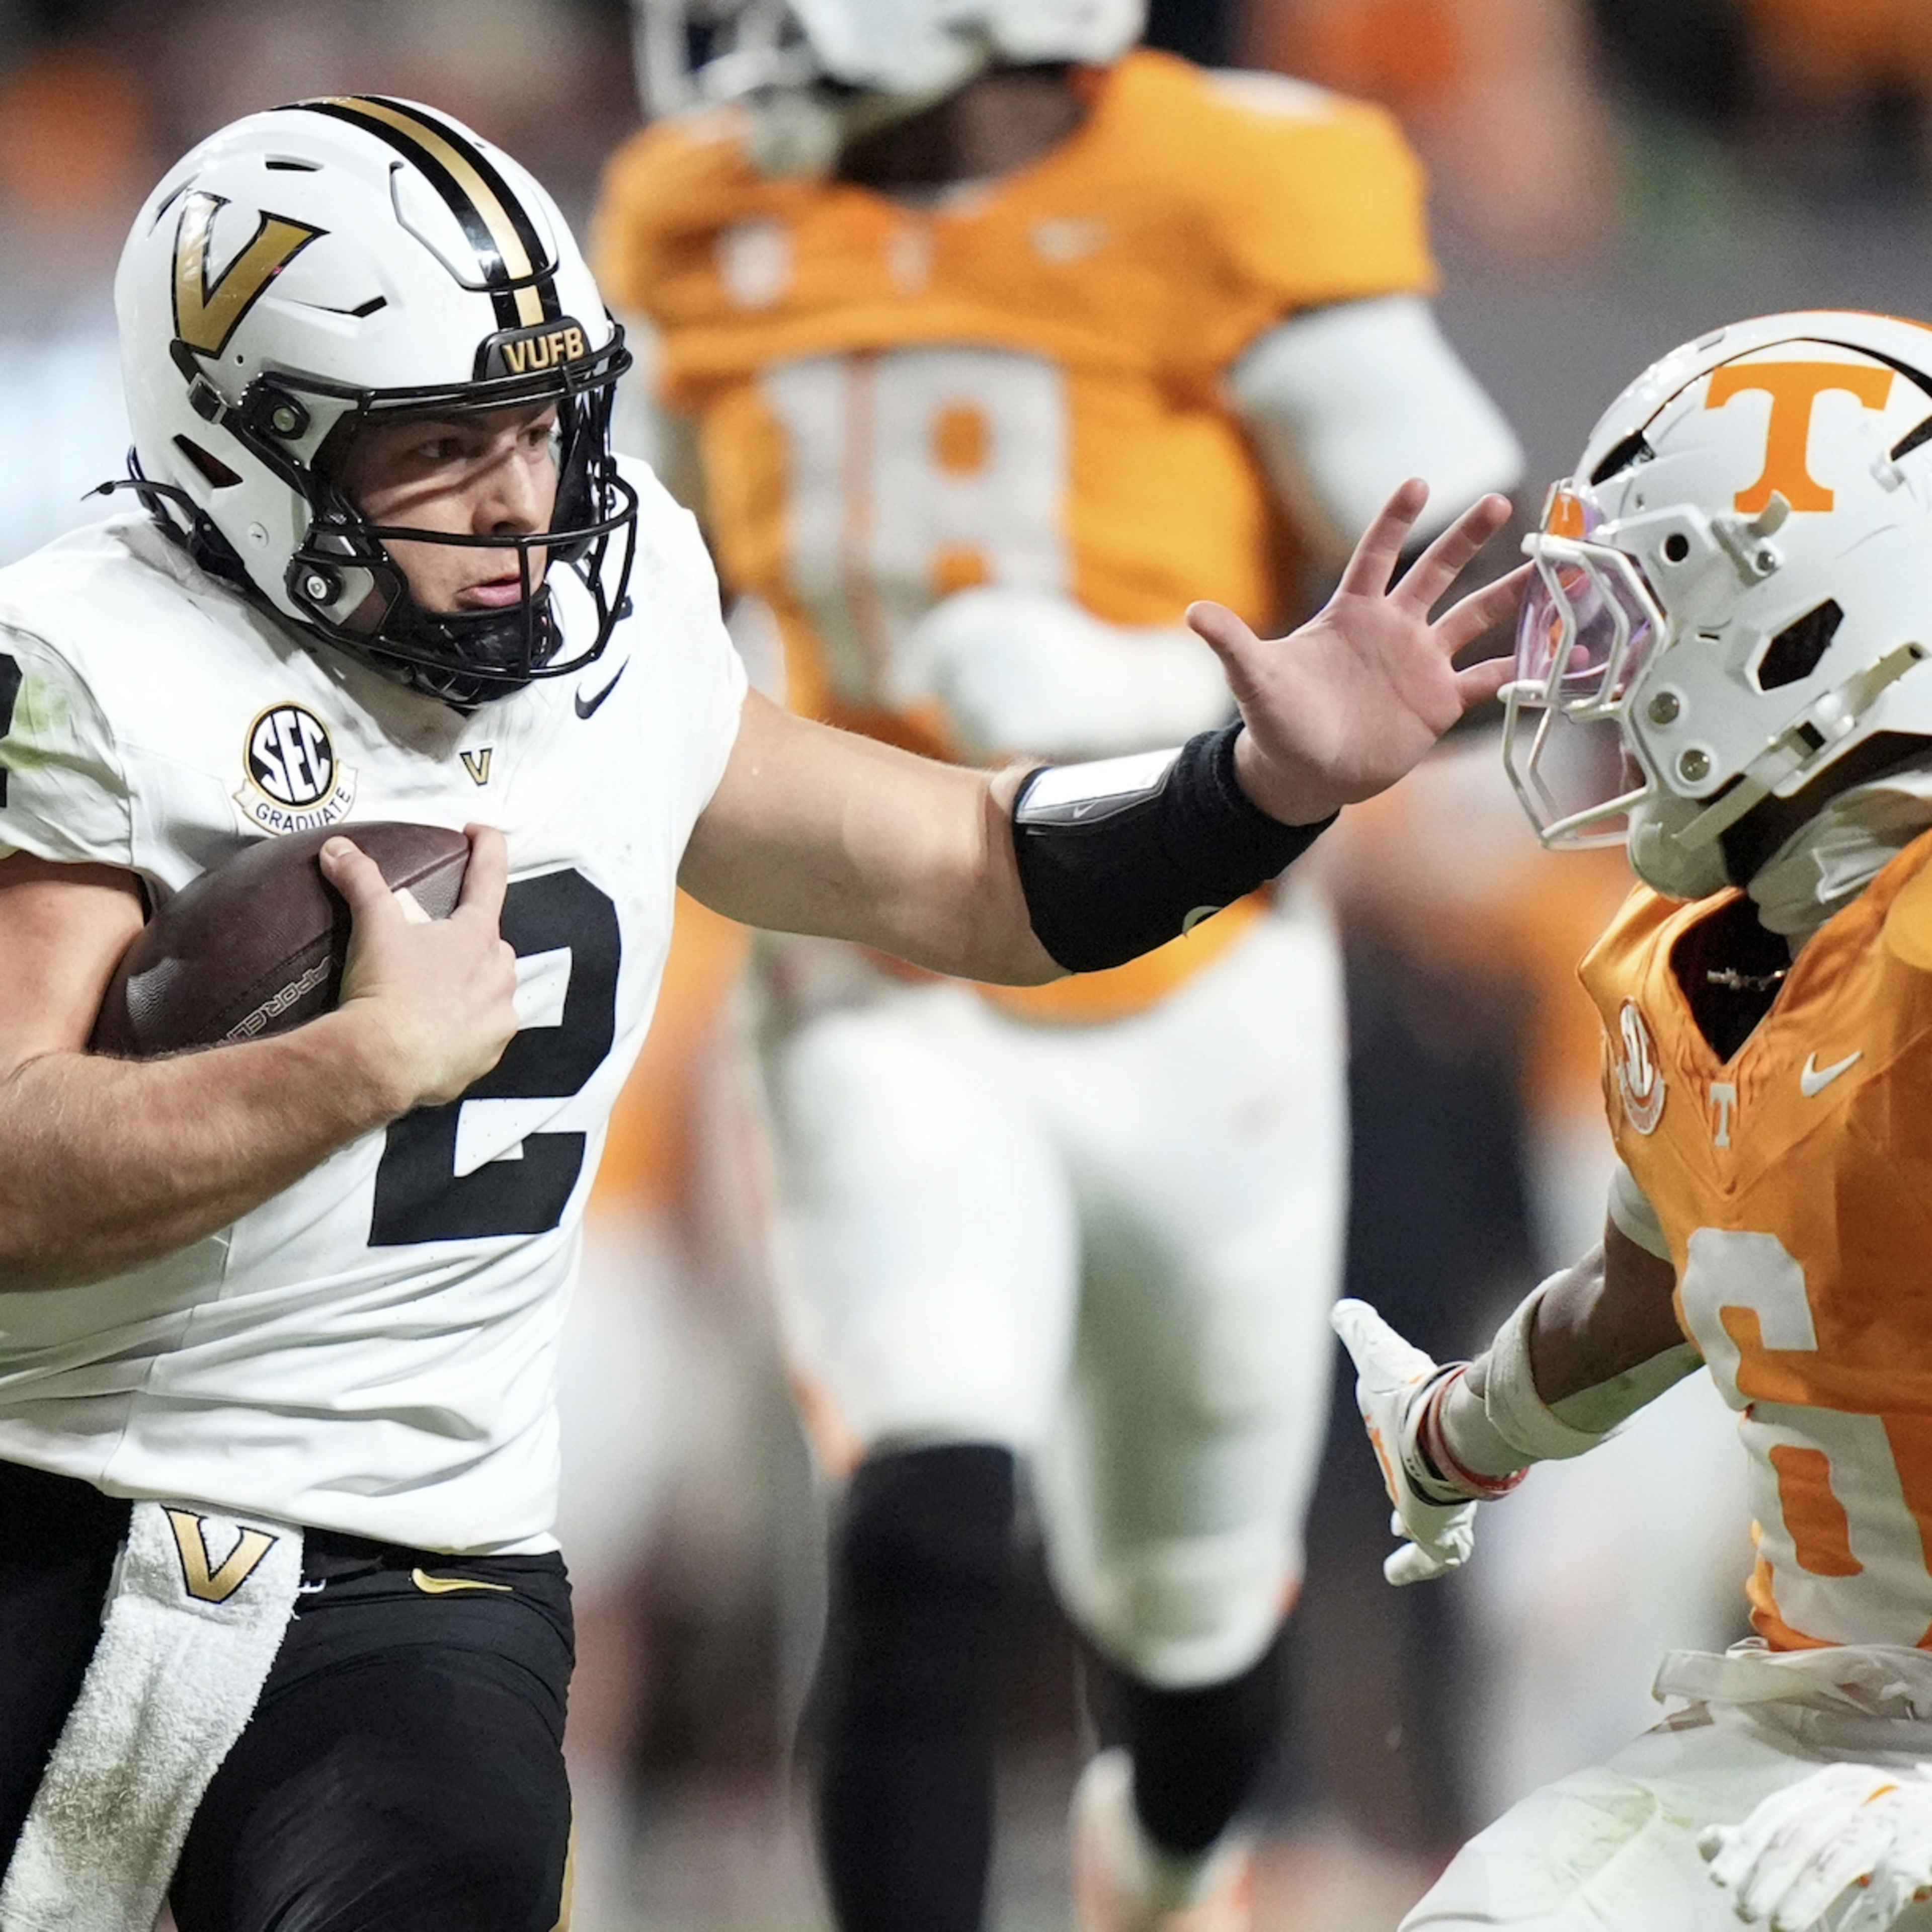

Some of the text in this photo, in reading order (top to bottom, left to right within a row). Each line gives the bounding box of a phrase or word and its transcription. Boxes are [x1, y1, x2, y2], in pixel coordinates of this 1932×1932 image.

[172, 190, 331, 359] V
[503, 327, 584, 373] VUFB
[1706, 361, 1895, 512] T
[252, 710, 331, 802] SEC
[460, 748, 492, 786] V
[256, 787, 351, 832] GRADUATE
[368, 868, 621, 1246] 2
[1711, 1082, 1737, 1147] T
[163, 1507, 279, 1603] V
